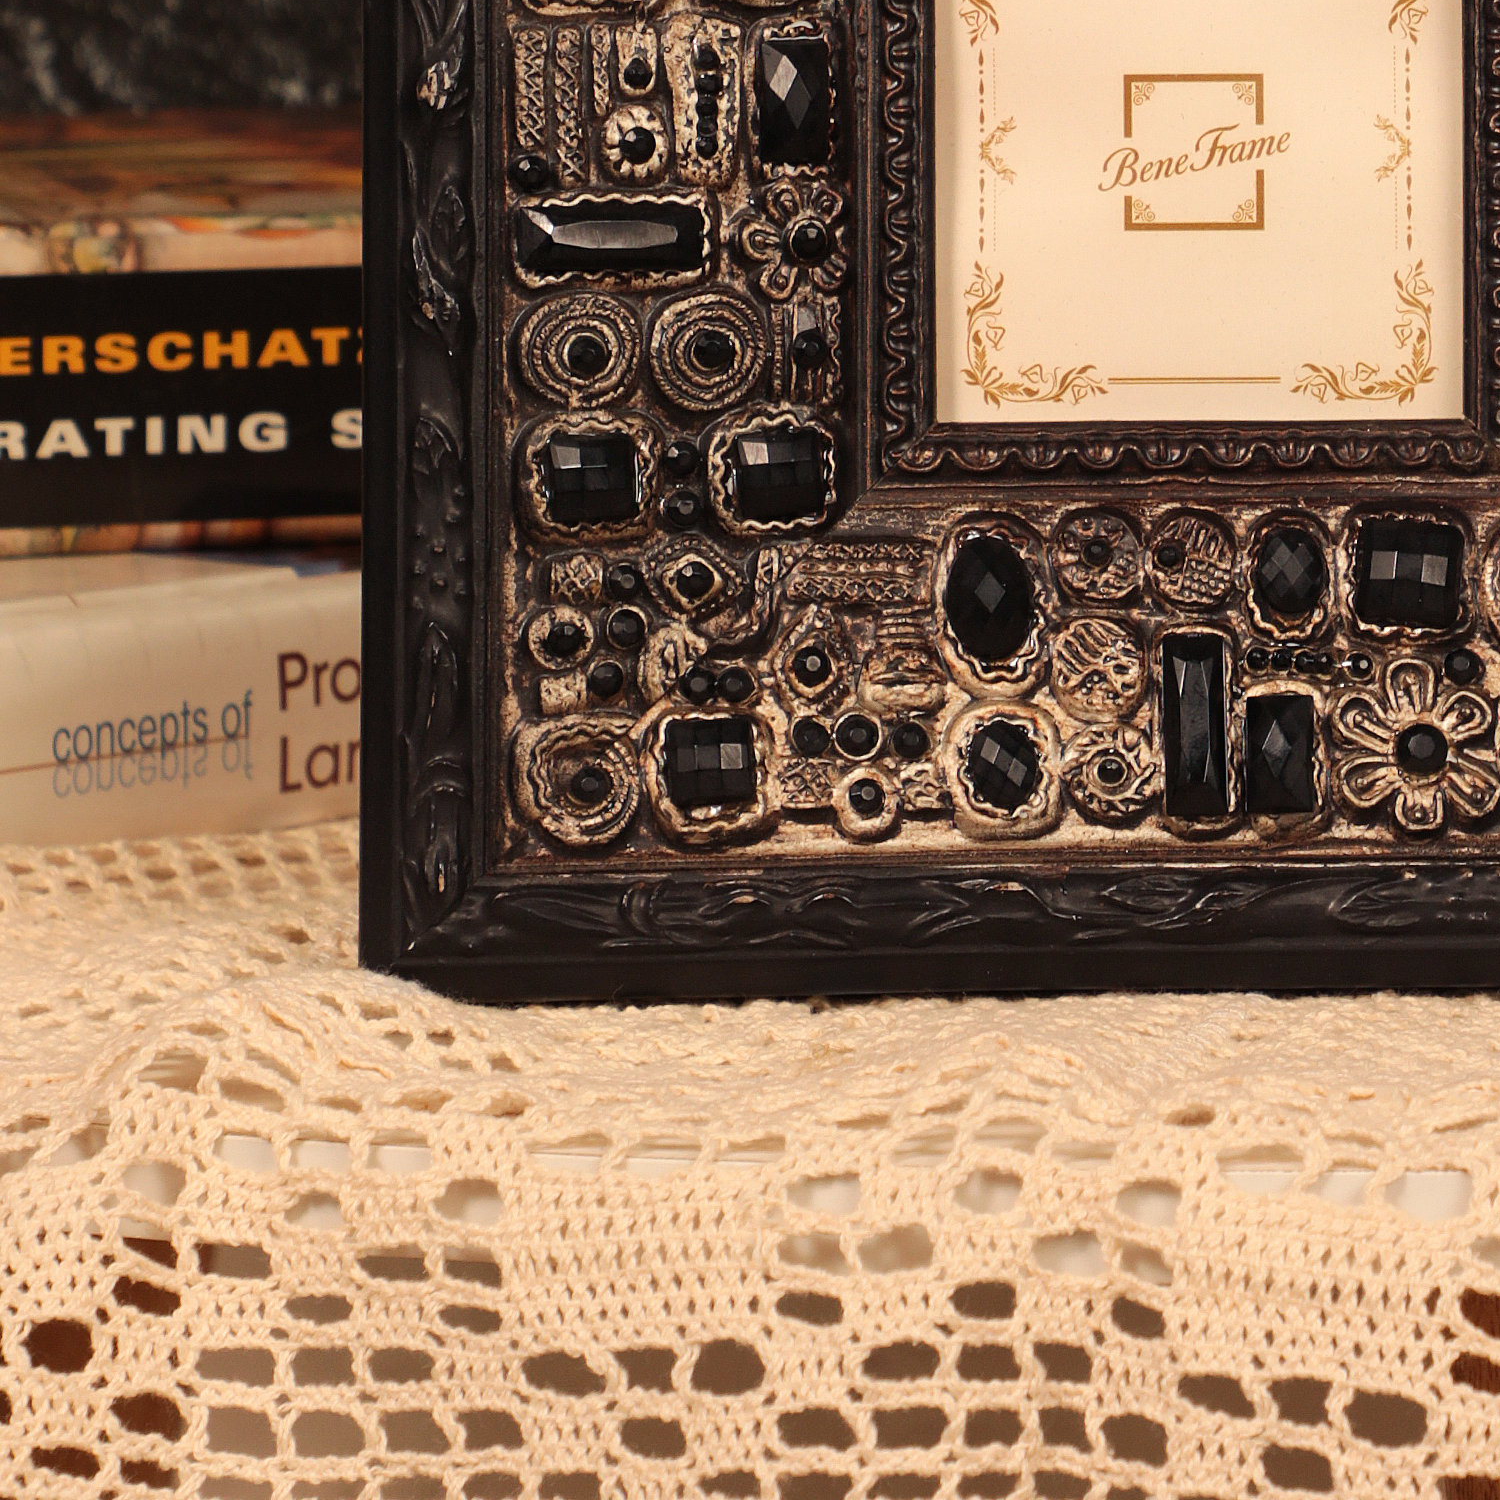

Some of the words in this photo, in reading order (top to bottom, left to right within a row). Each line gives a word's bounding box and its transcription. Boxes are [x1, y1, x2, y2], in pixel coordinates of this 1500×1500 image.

[0, 326, 363, 376] ERSCHAT
[52, 700, 209, 764] concepts
[220, 688, 254, 741] of
